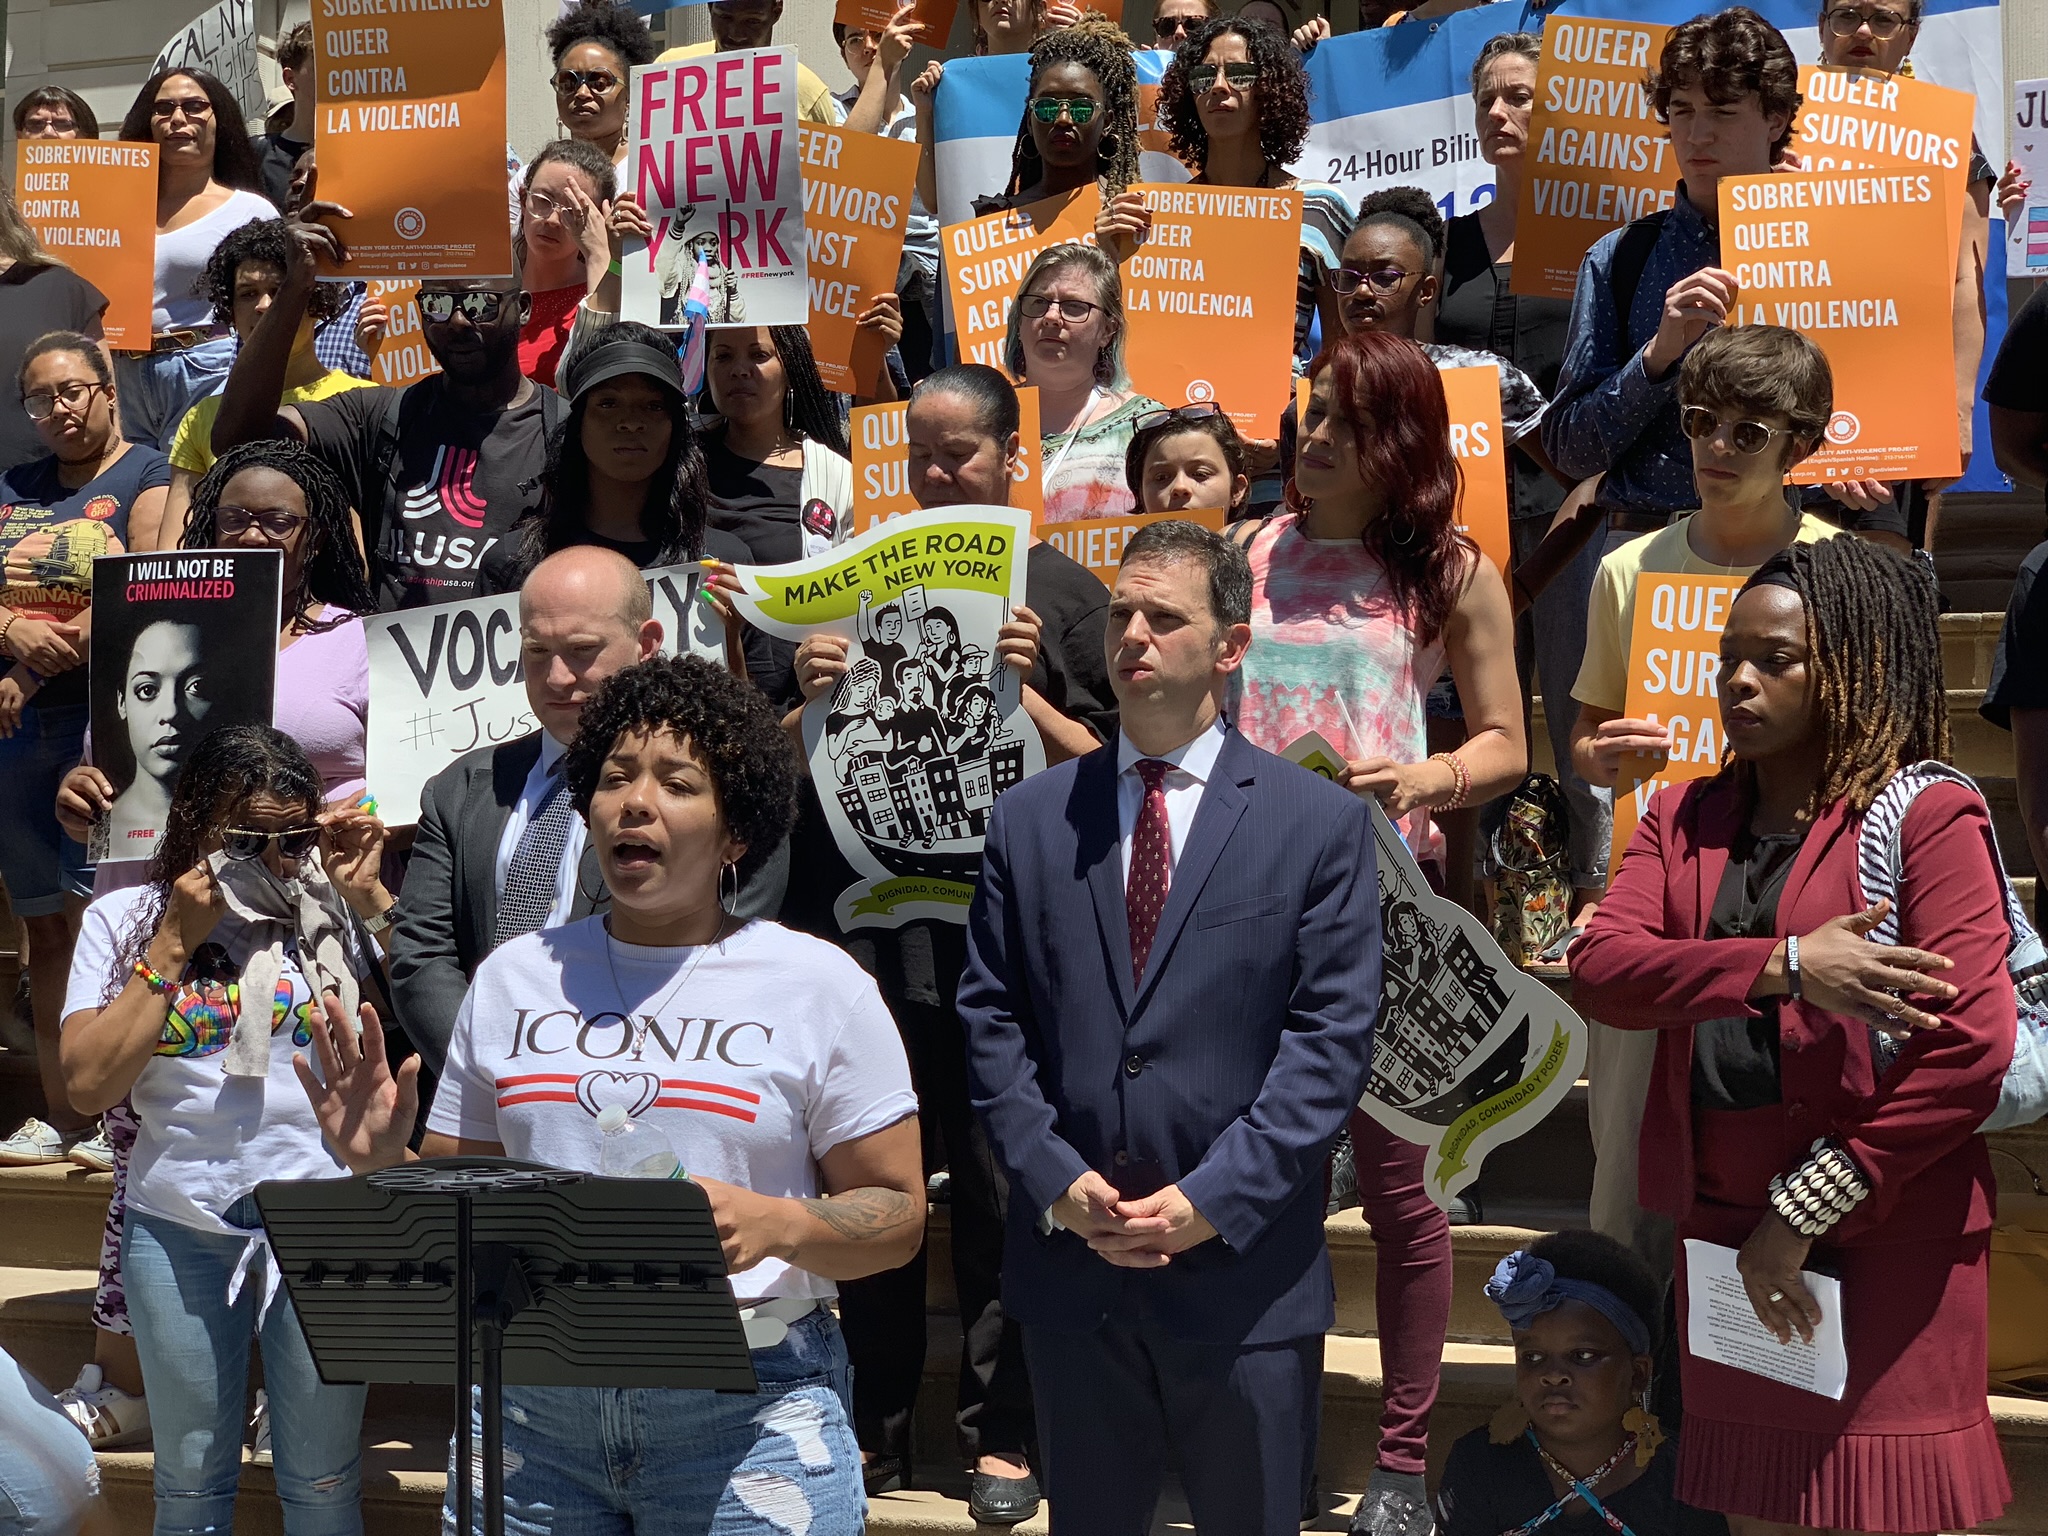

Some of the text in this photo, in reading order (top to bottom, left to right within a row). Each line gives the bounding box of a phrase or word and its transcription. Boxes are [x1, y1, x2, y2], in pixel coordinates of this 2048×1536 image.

[323, 0, 490, 17] SOBREVIVI
[326, 28, 389, 58] QUEER
[1554, 25, 1650, 67] QUEER
[328, 67, 407, 96] CONTRA
[1808, 72, 1899, 112] QUEER
[640, 54, 783, 140] FREE
[327, 102, 461, 134] LA VIOLENCIA
[1537, 127, 1670, 173] AGAINST
[1801, 113, 1959, 168] SURVIVORS
[26, 146, 150, 168] SOBREVIVIENTES
[635, 129, 783, 210] NEW
[1327, 148, 1424, 184] 24-Hour
[25, 173, 69, 192] QUEER
[1732, 175, 1932, 212] SOBREVIVIENTES
[23, 200, 80, 218] CONTRA
[1533, 178, 1675, 222] VIOLENCE
[44, 227, 121, 247] VIOLENCIA
[645, 207, 793, 273] YRK
[953, 215, 1034, 257] QUEER
[1734, 221, 1809, 251] QUEER
[741, 270, 795, 278] #FREEnewyork
[1130, 256, 1205, 282] CONTRA
[1737, 260, 1832, 290] CONTRA
[1128, 289, 1253, 318] LA VIOLENCIA
[1775, 299, 1898, 330] VIOLENCIA
[1808, 456, 1855, 465] (English/Spanish
[1836, 447, 1886, 455] ANTI-VIOLENCE
[1869, 466, 1908, 474] @antiviolence
[91, 508, 108, 517] OFF!
[92, 500, 112, 510] 20%
[129, 559, 234, 581] I WILL NOT BE
[785, 533, 1007, 607] MAKE THE ROAD
[884, 559, 1003, 590] NEW YORK
[126, 581, 235, 602] CRIMINALIZED
[387, 608, 524, 699] VOC
[878, 885, 930, 902] DIGNIDAD,
[504, 1008, 774, 1067] ICONIC
[1447, 1040, 1565, 1160] DIGNIDAD, COMUNIDAD Y PODER
